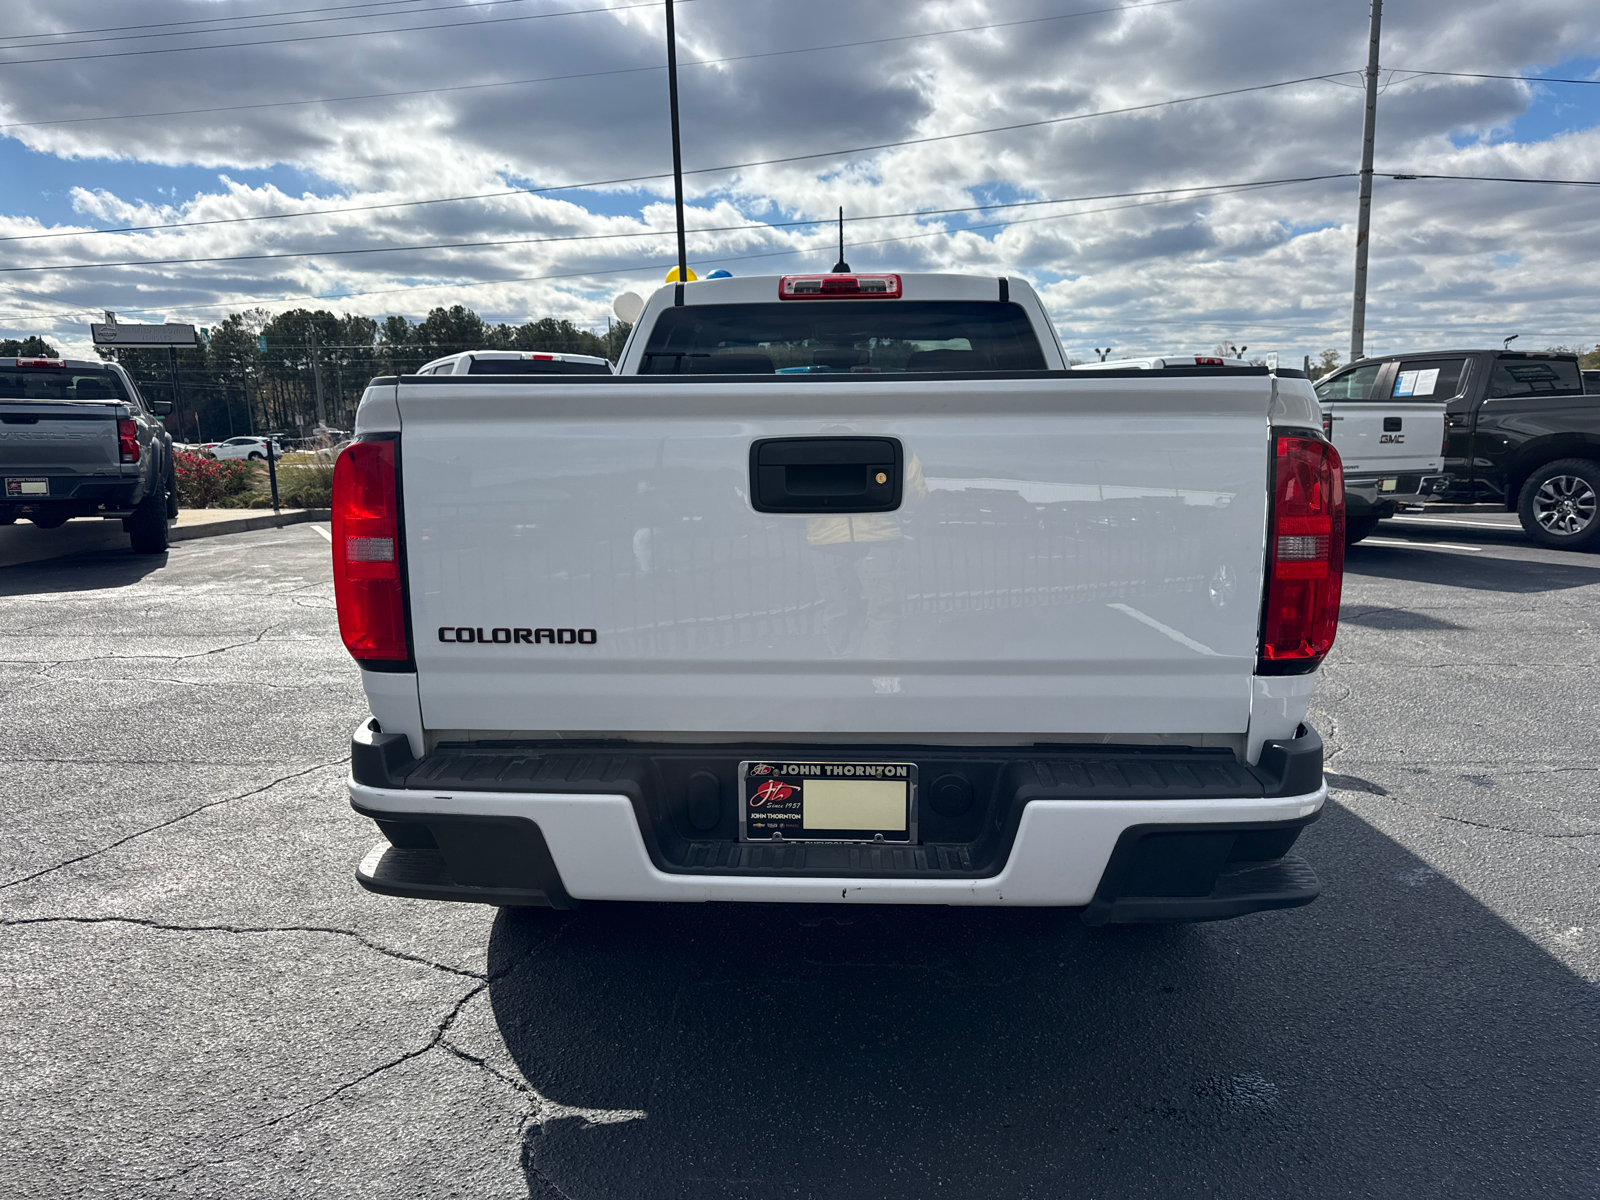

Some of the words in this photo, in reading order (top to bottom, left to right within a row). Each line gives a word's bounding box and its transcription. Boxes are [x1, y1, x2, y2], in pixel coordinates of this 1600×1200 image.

[1379, 434, 1405, 444] GMC
[438, 626, 597, 644] COLORADO
[780, 764, 821, 775] JOHN
[825, 765, 907, 777] THORNTON
